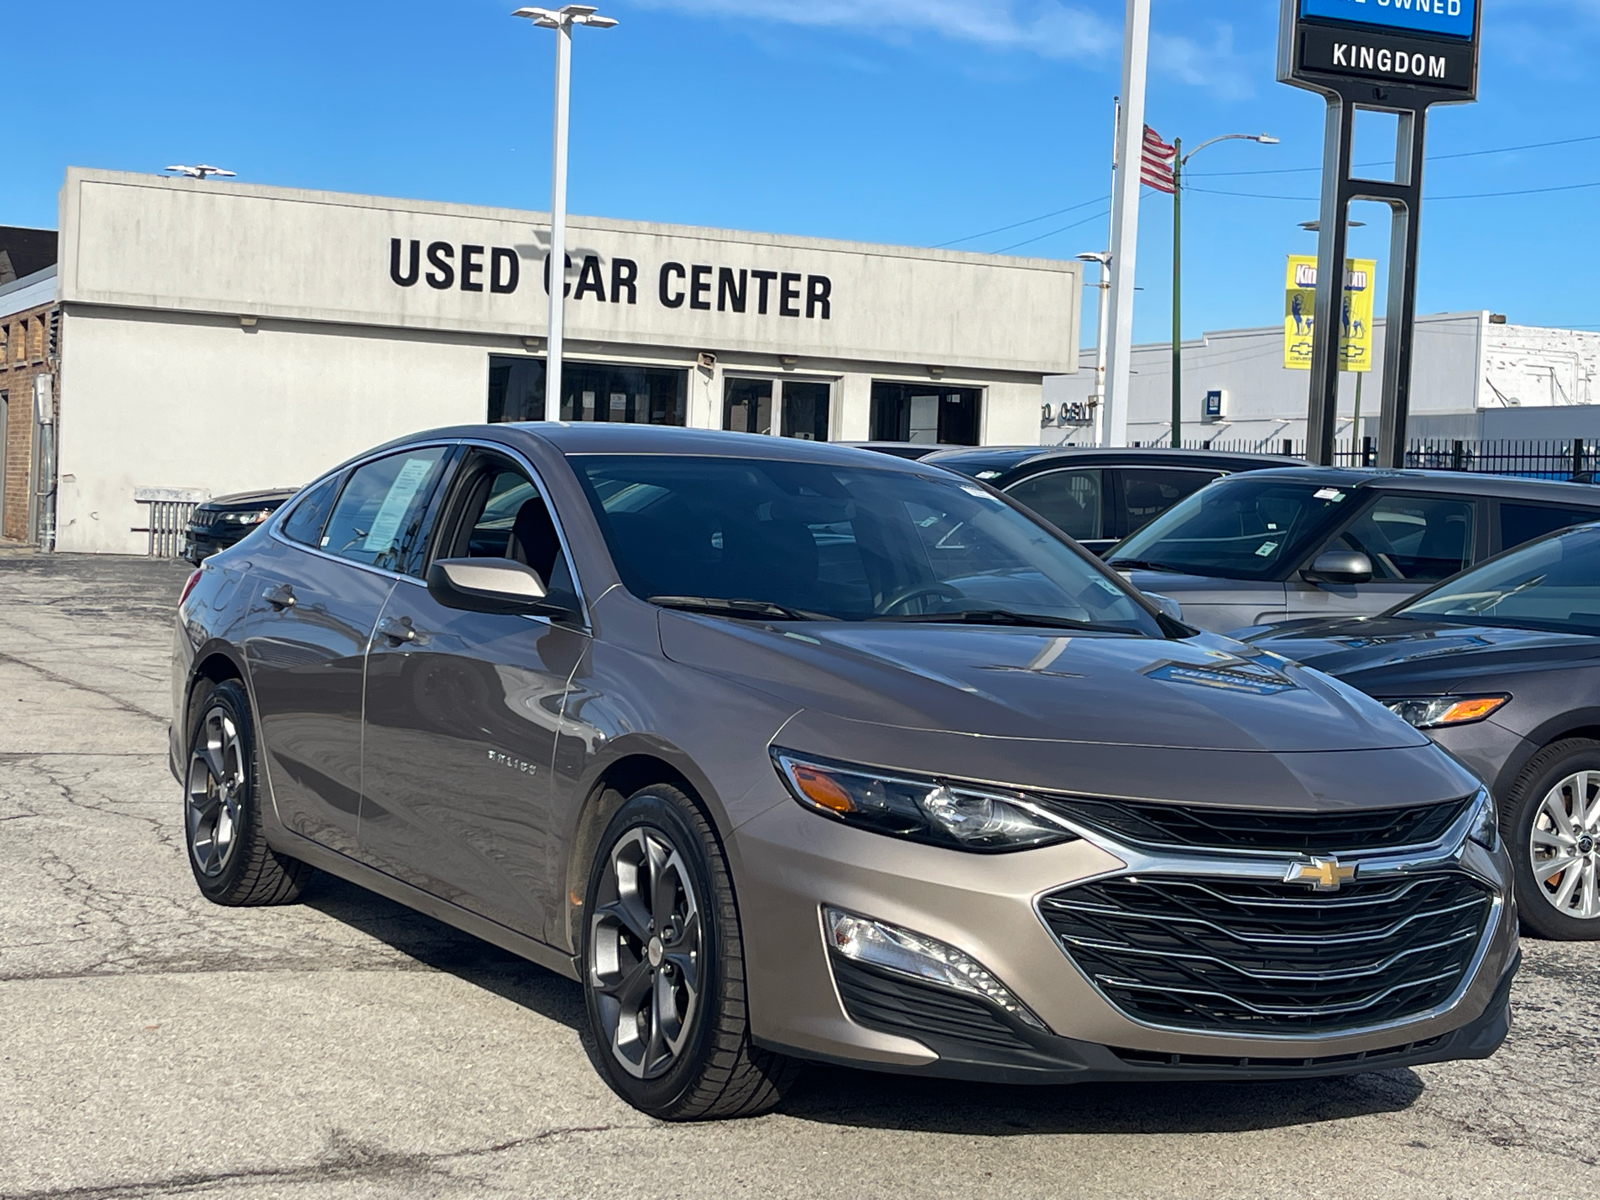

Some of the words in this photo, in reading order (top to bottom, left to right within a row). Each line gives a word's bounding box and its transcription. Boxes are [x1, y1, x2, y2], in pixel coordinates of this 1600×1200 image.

[1332, 43, 1446, 78] KINGDOM
[389, 237, 520, 295] USED
[658, 261, 832, 320] CENTER
